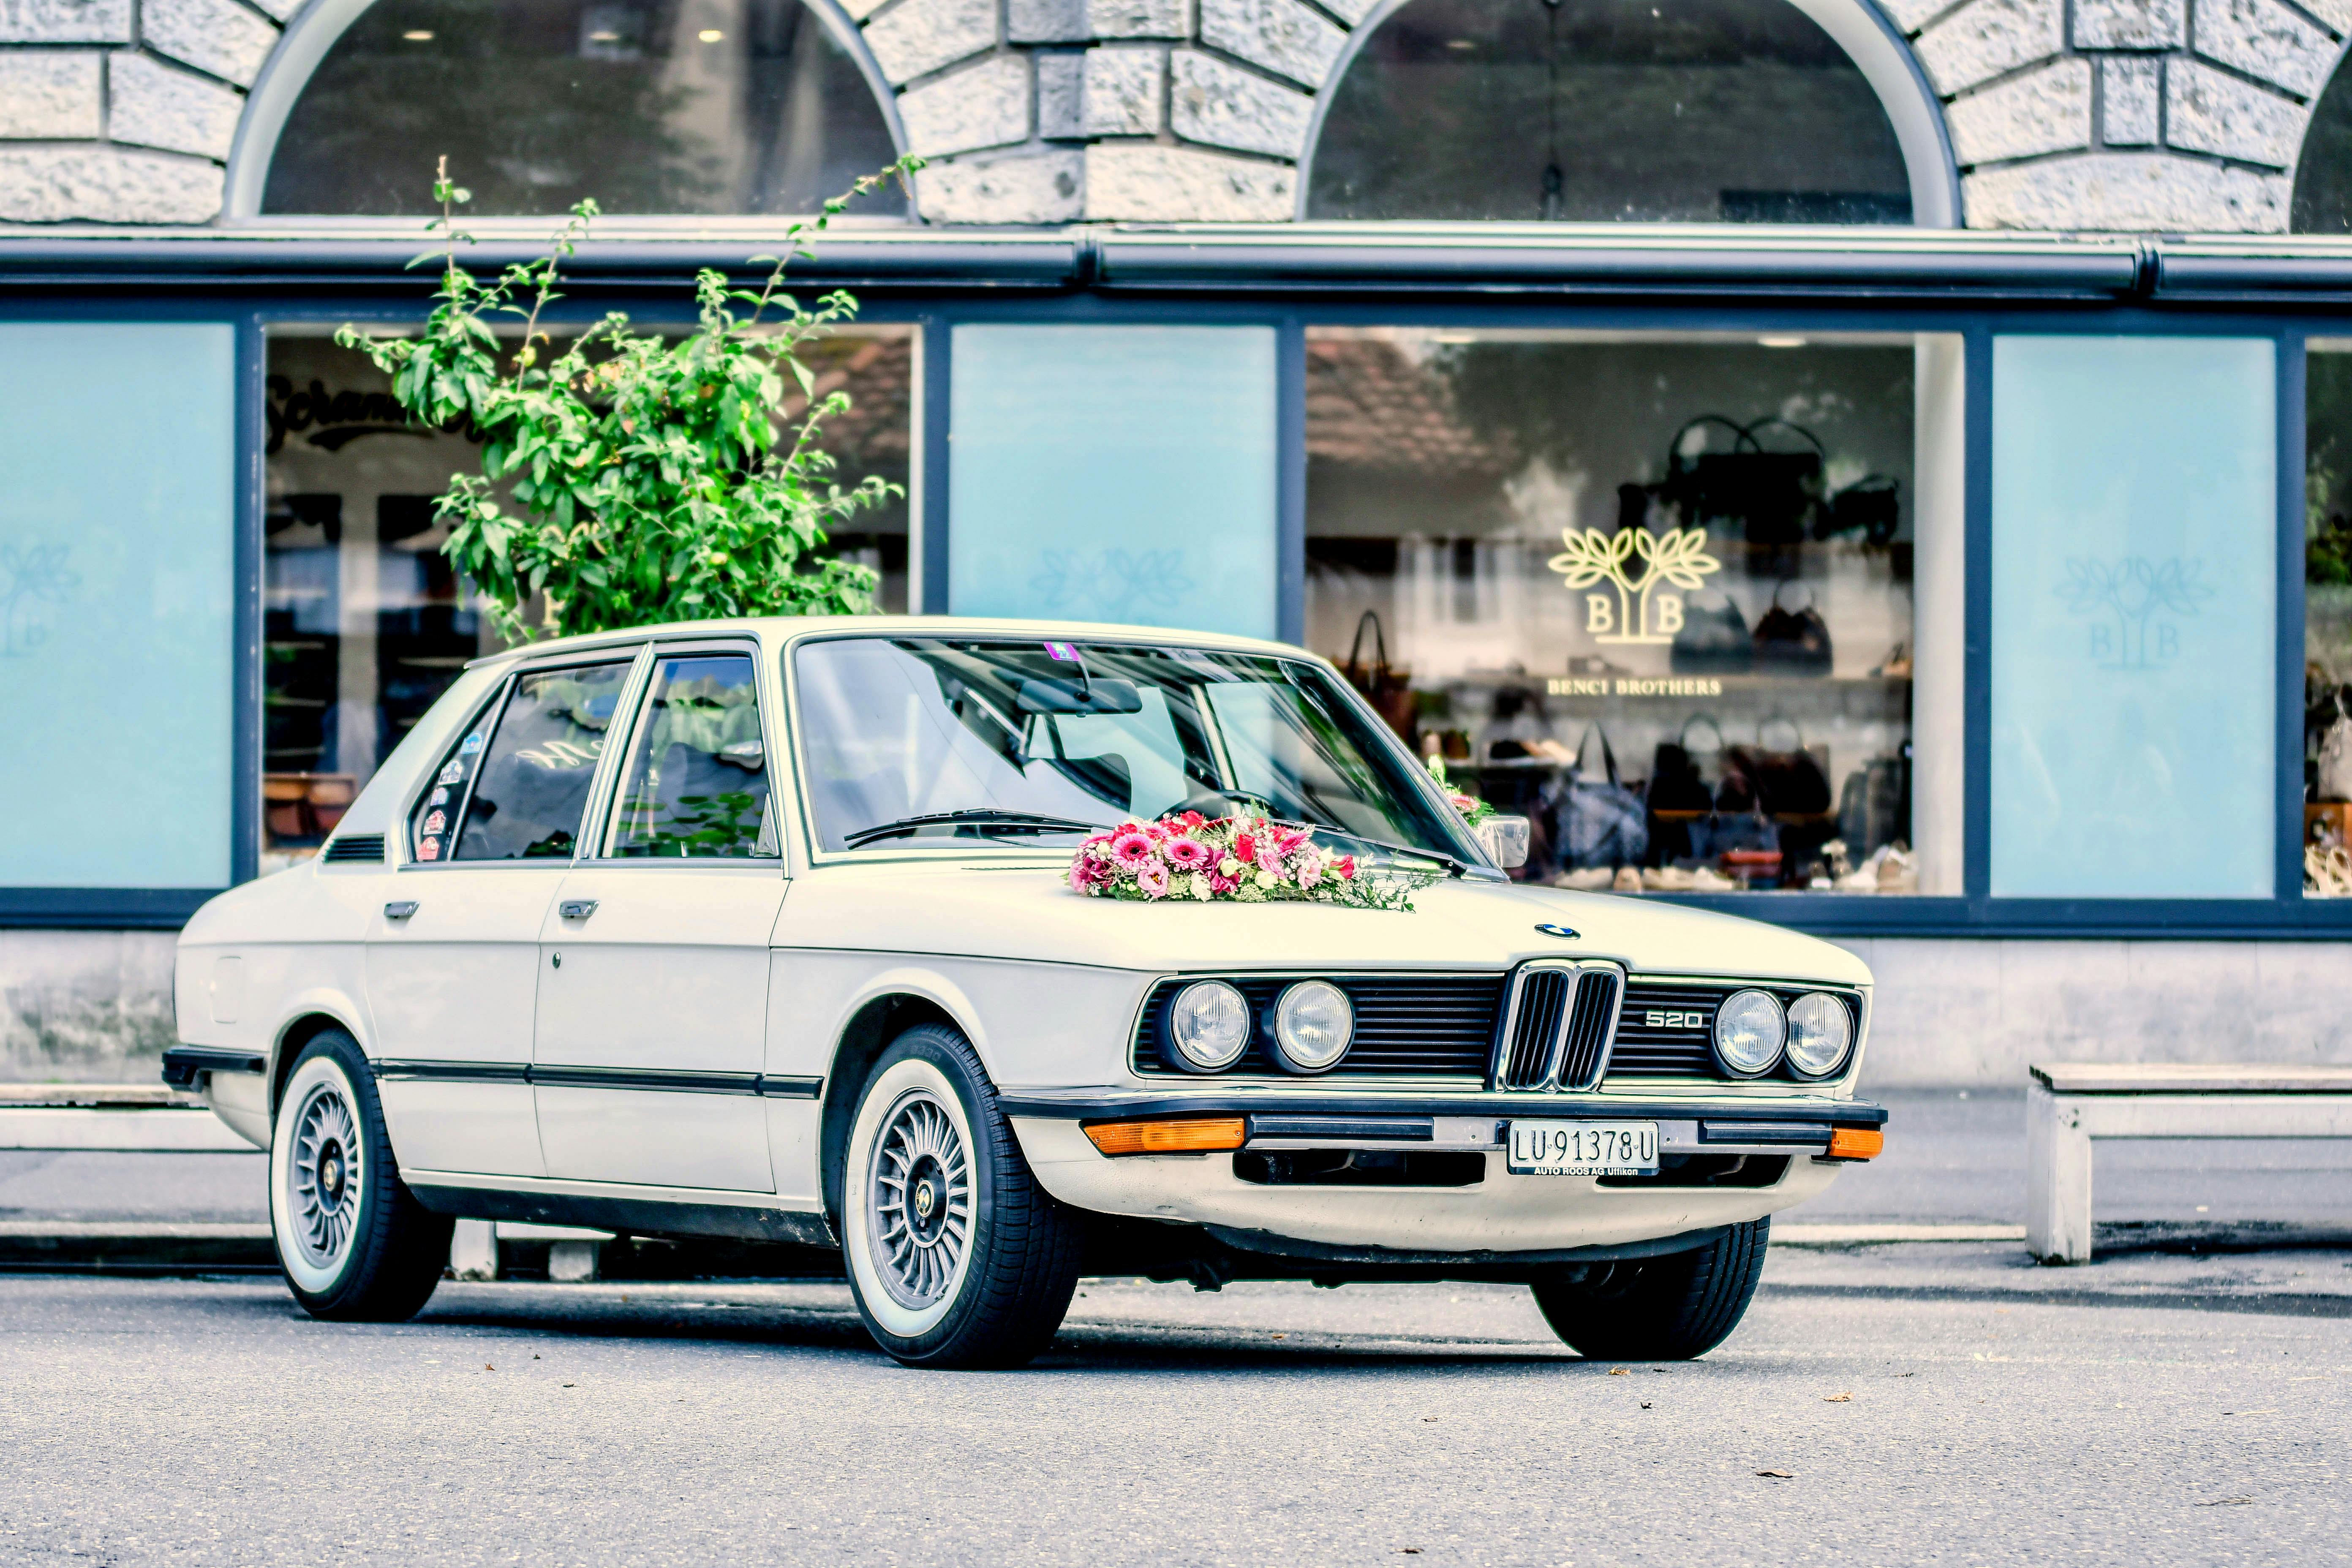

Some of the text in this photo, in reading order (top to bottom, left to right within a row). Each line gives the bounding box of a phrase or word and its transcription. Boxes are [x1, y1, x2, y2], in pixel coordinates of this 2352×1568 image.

[1548, 680, 1721, 696] BENCI BROTHERS
[1646, 1011, 1702, 1028] 520
[1563, 1167, 1589, 1175] ROOS
[1591, 1167, 1604, 1176] AG
[1607, 1168, 1638, 1176] Uffikon
